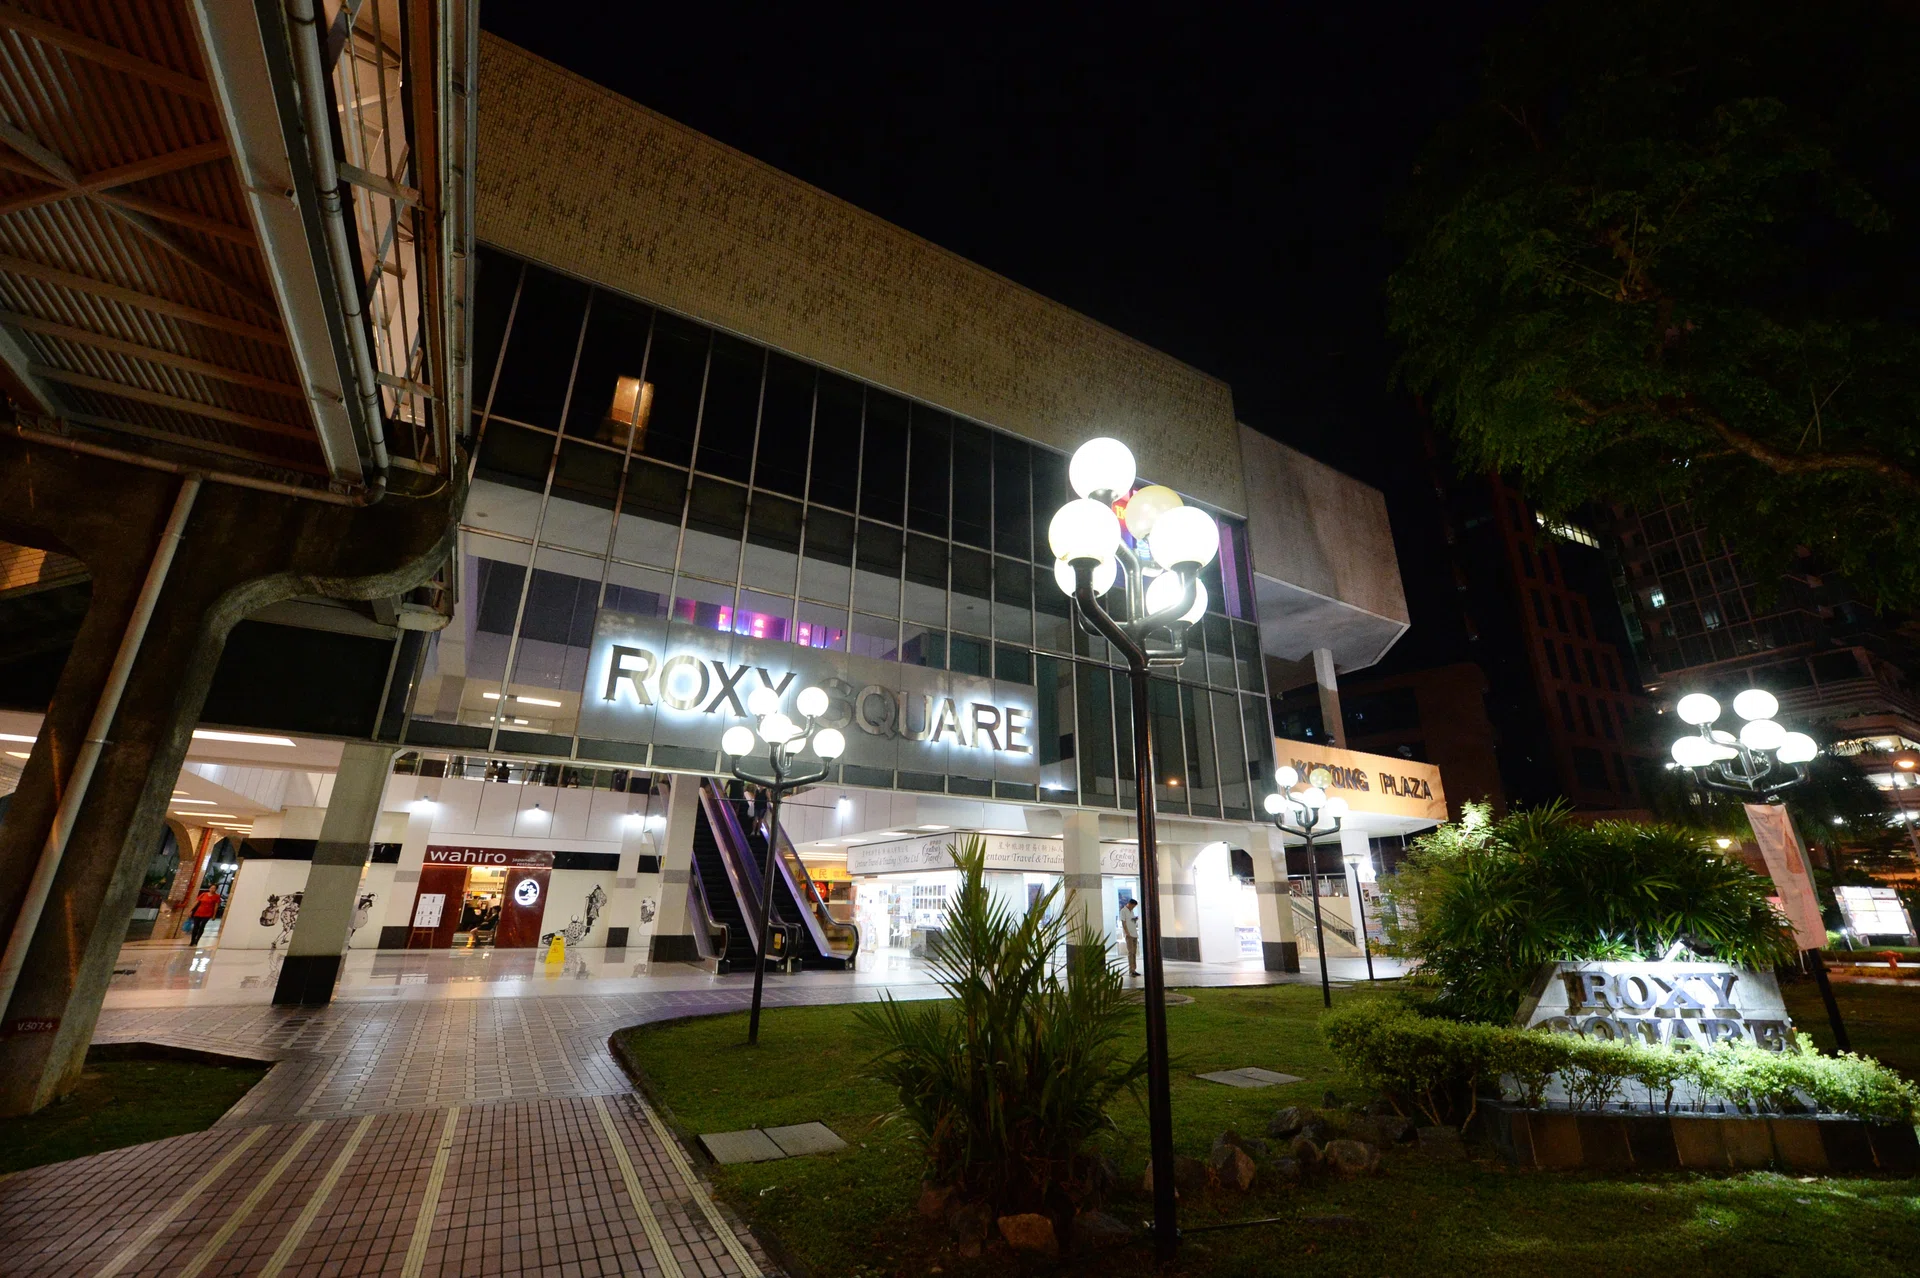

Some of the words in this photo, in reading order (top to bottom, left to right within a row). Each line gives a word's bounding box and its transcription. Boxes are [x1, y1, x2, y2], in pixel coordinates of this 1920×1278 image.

[602, 644, 797, 718] ROXY
[814, 677, 1034, 754] SQUARE
[1290, 758, 1370, 792] KONG
[1379, 772, 1434, 800] PLAZA
[430, 849, 507, 864] wahiro
[985, 853, 1009, 861] entour
[1011, 853, 1036, 863] Travel
[1042, 854, 1064, 864] Tradin
[1560, 970, 1739, 1016] ROXY
